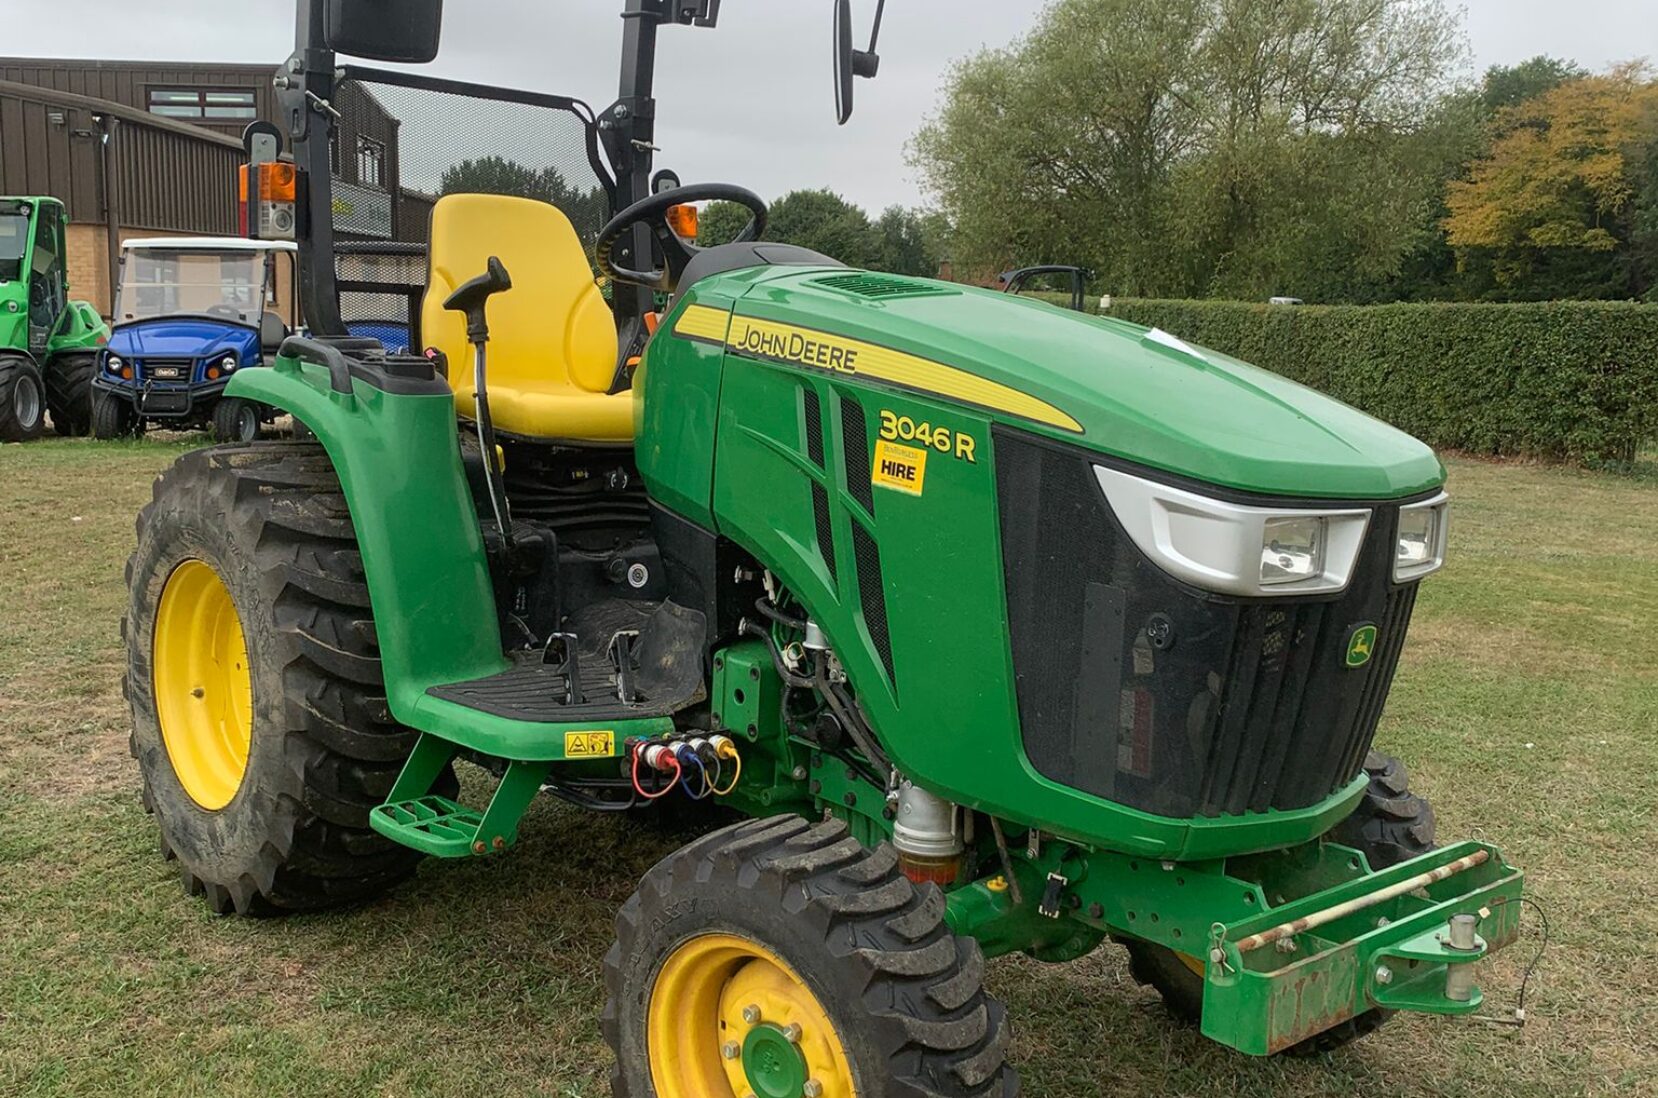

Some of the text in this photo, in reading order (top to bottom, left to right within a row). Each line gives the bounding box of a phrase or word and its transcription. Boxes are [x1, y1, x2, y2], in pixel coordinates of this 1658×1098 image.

[737, 325, 858, 371] JOHN DEERE
[879, 408, 952, 453] 3046
[954, 431, 976, 464] R
[881, 459, 917, 482] HIRE
